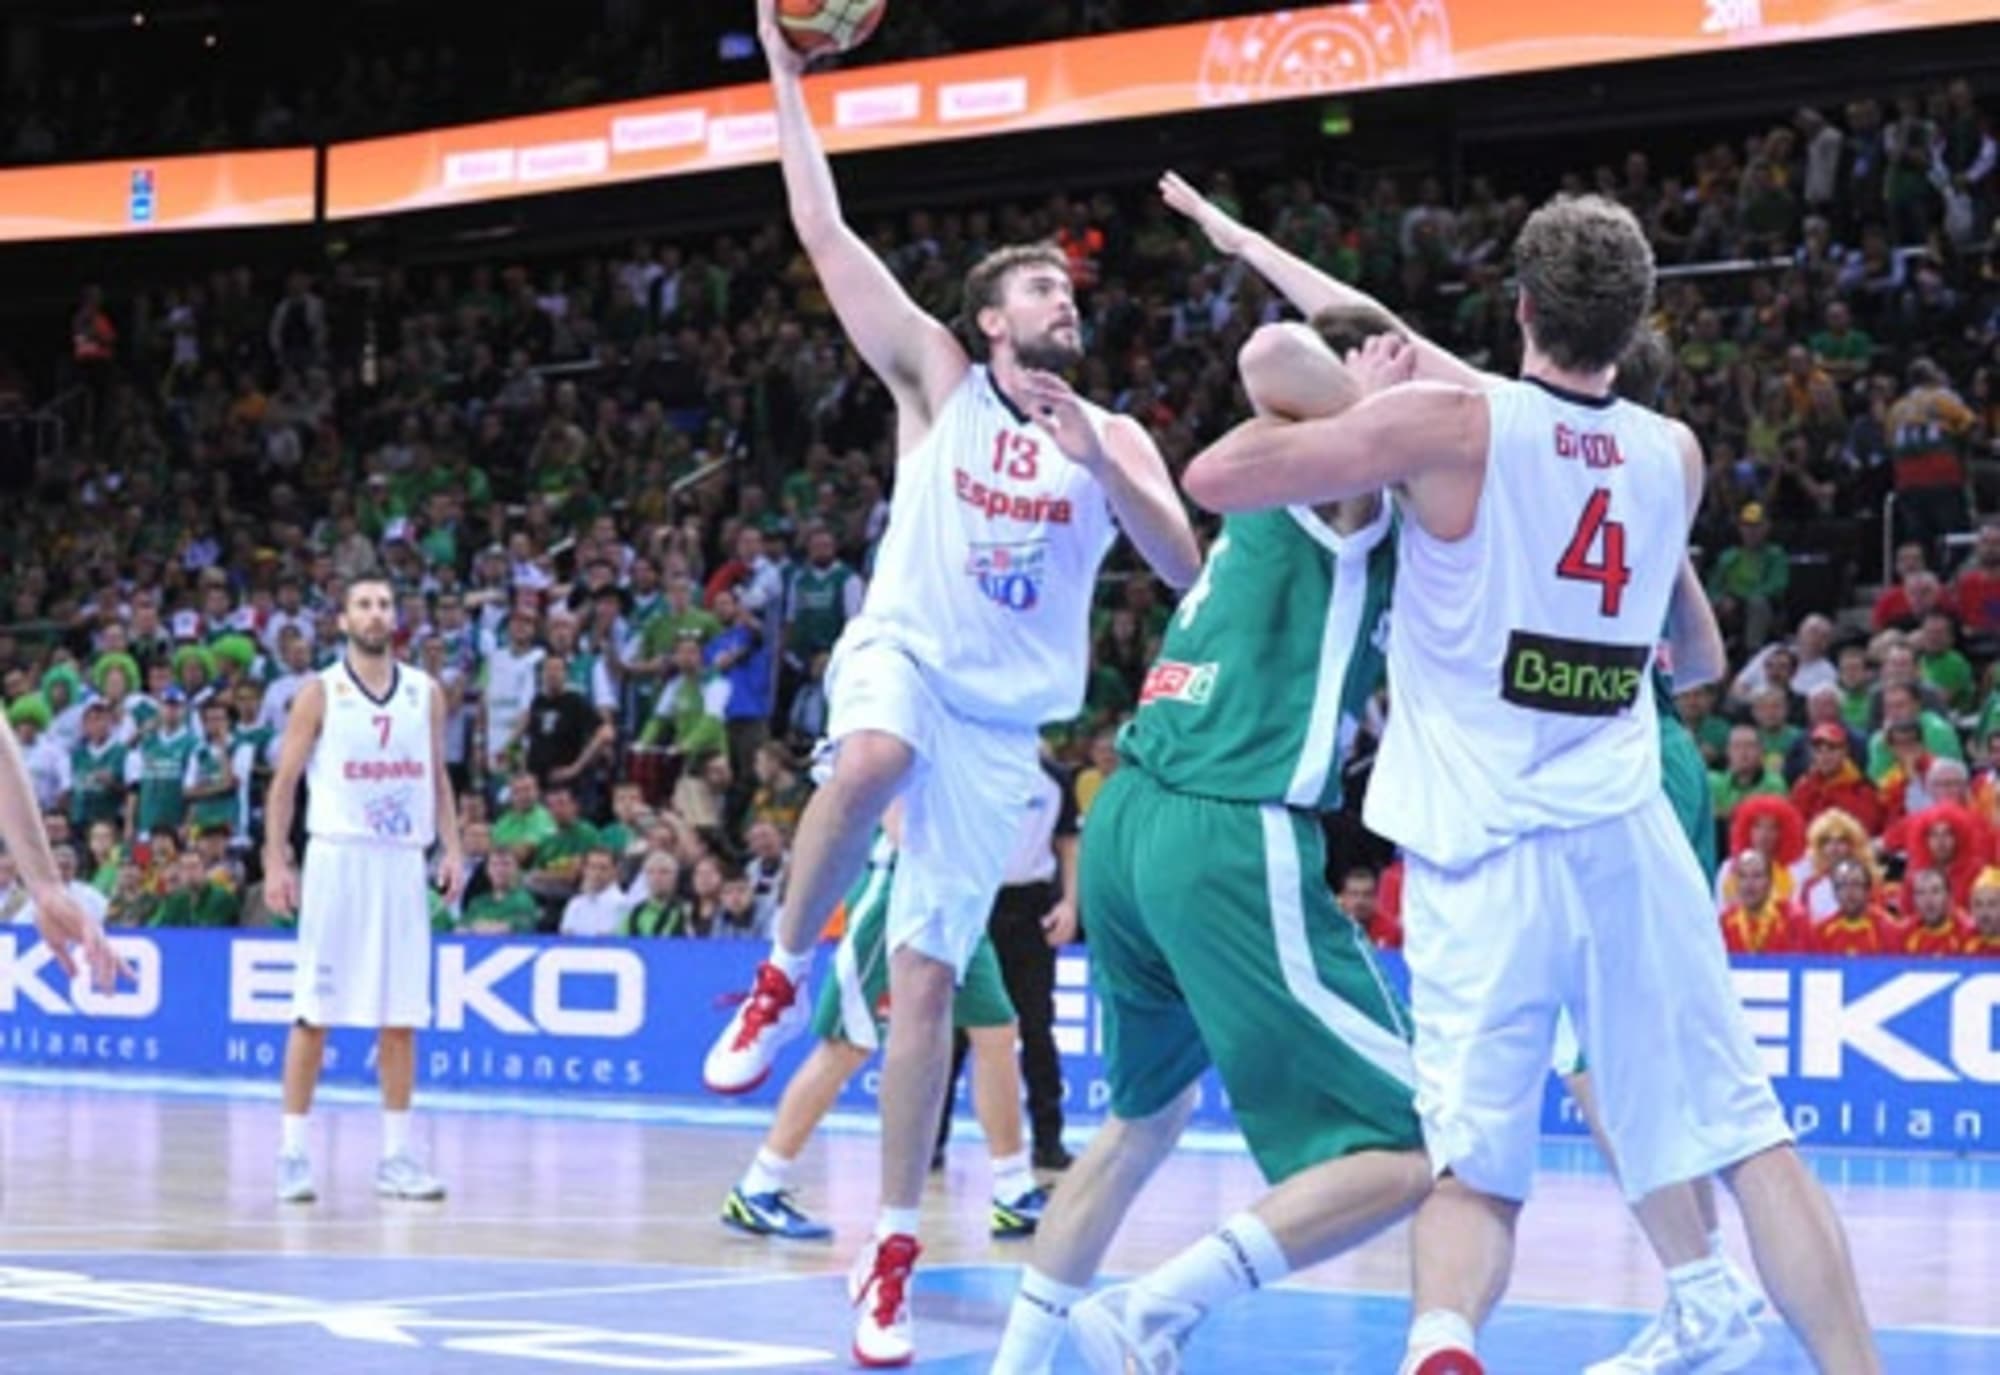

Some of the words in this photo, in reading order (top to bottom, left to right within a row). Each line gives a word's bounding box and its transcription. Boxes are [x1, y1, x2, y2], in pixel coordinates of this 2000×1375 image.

[991, 429, 1039, 481] 13
[1555, 487, 1632, 618] 4
[371, 713, 391, 750] 7
